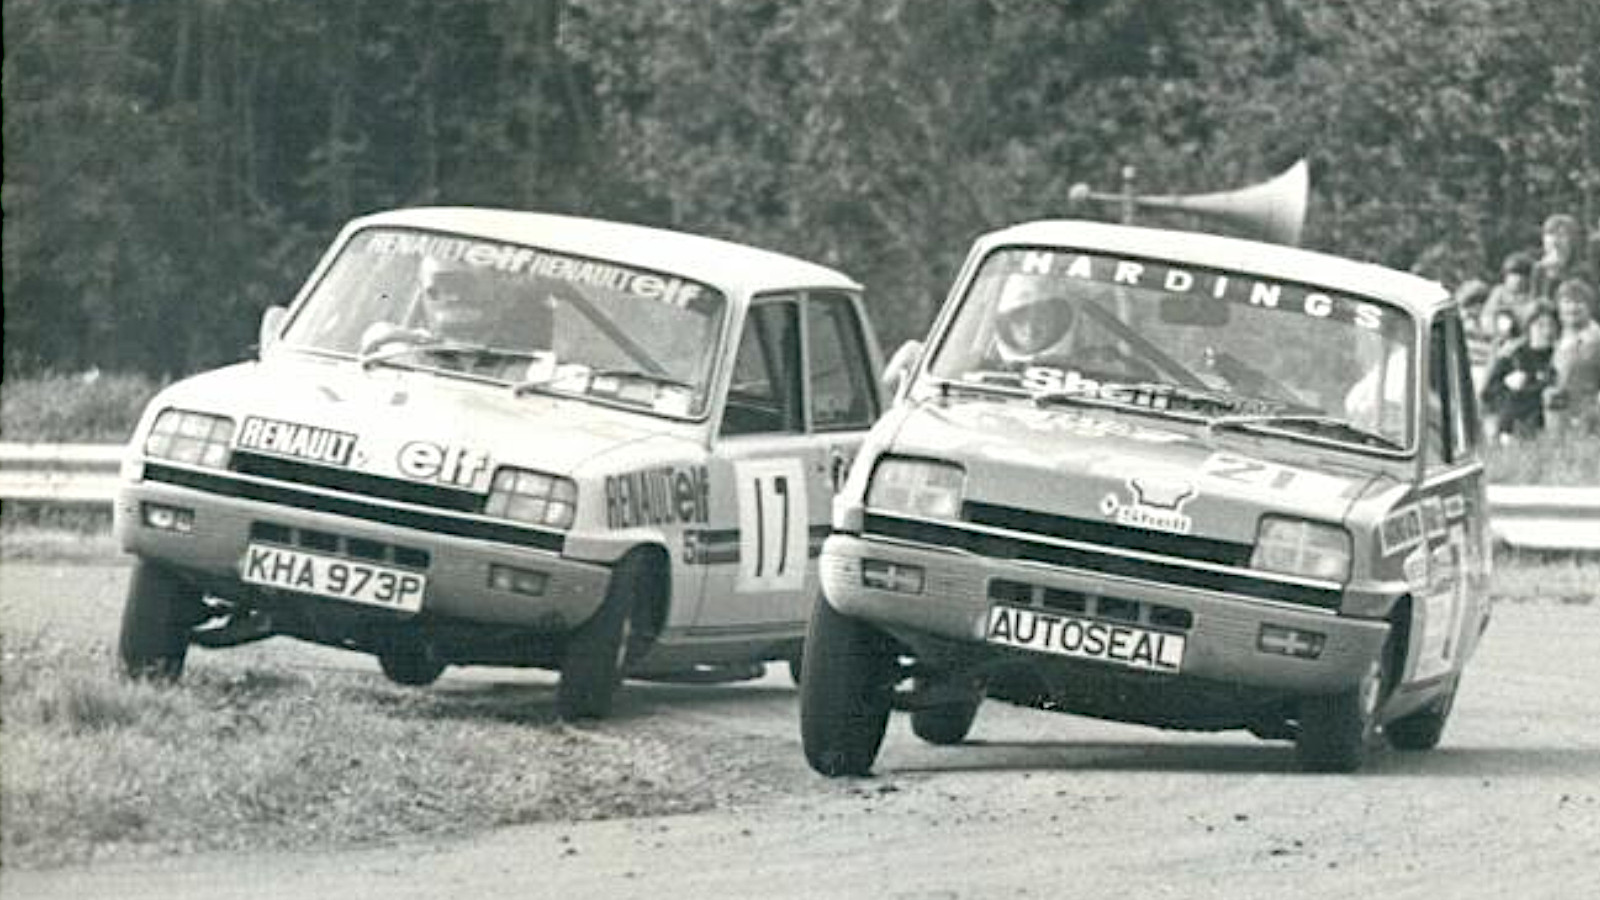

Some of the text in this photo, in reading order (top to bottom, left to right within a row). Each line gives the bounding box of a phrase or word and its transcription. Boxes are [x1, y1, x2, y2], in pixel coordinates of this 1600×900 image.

[464, 244, 535, 273] elf
[631, 274, 702, 307] elf
[1021, 251, 1384, 330] HARDINGS
[239, 417, 358, 465] RENAULT
[397, 440, 492, 488] elf
[605, 465, 710, 530] RENAULT elf
[754, 475, 789, 578] 17
[248, 548, 422, 605] KHA 973P
[988, 609, 1178, 669] AUTOSEAL
